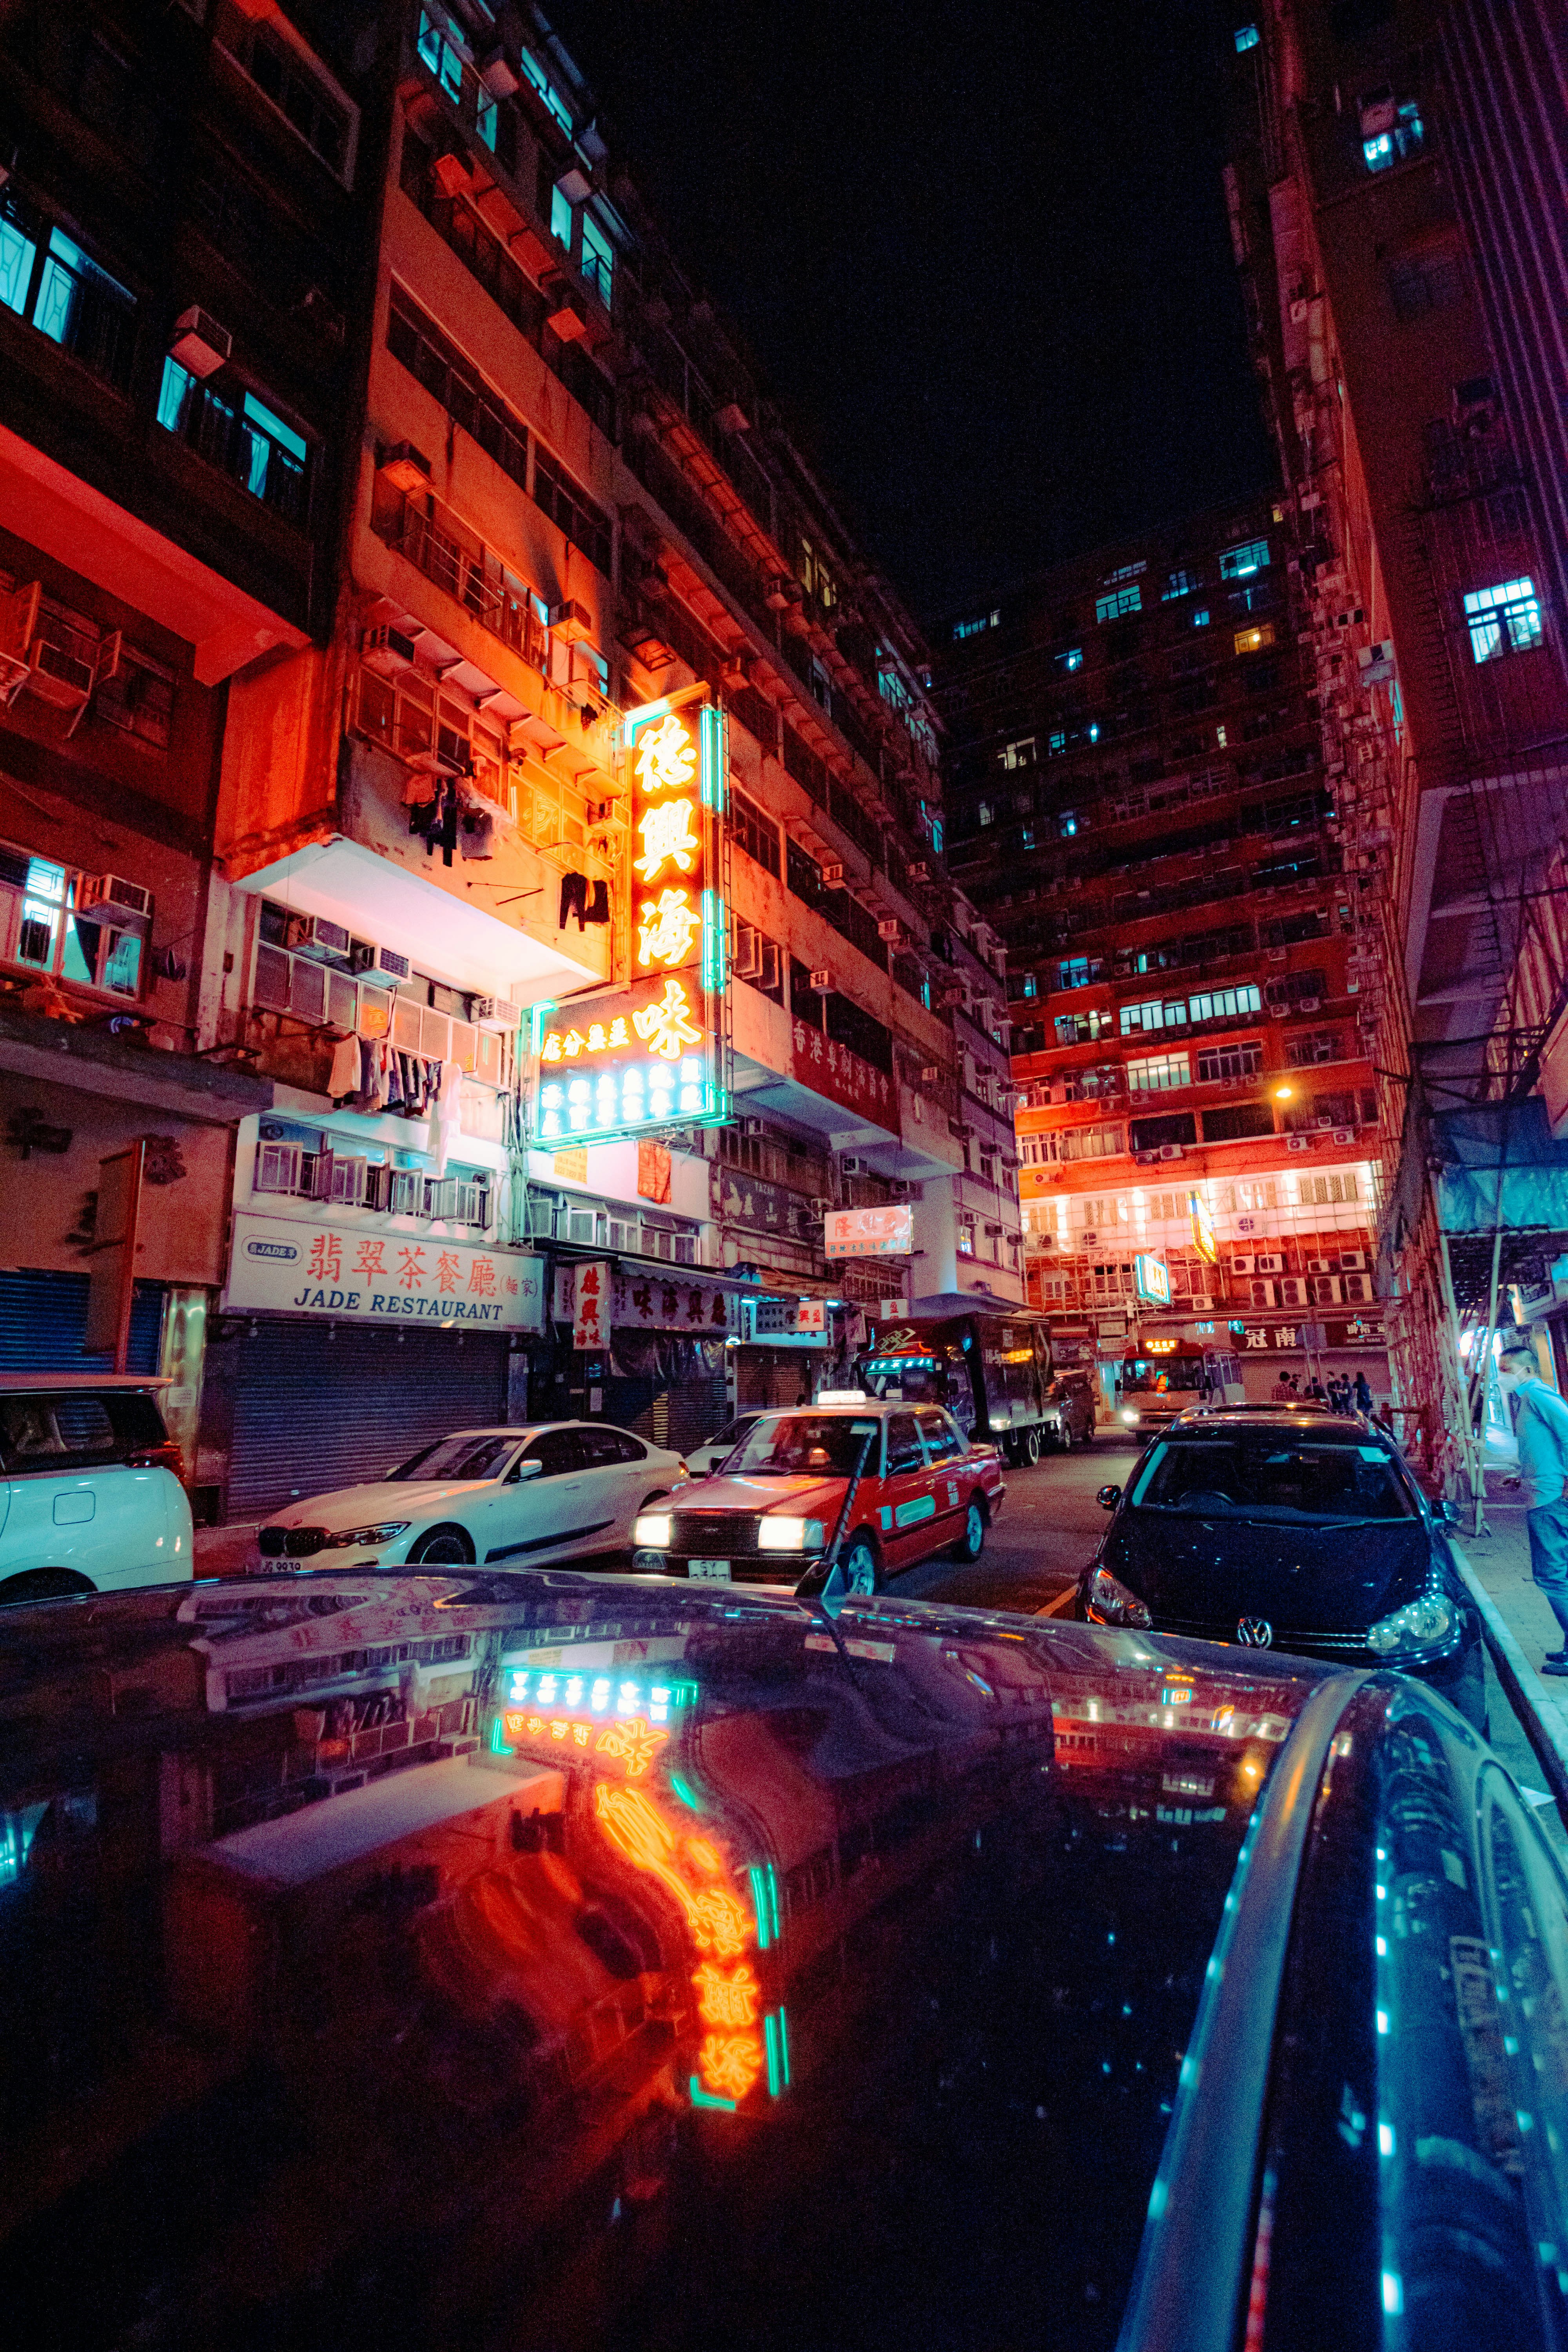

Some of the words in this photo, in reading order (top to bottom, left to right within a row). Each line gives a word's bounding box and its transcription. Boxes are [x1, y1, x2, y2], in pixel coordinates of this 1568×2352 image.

[633, 713, 702, 1061] 德興海味
[258, 1245, 287, 1256] JADE
[307, 1232, 496, 1297] 翡翠茶餐廳
[294, 1287, 361, 1310] JADE
[369, 1294, 503, 1321] RESTAURANT
[1244, 1327, 1297, 1348] 冠南
